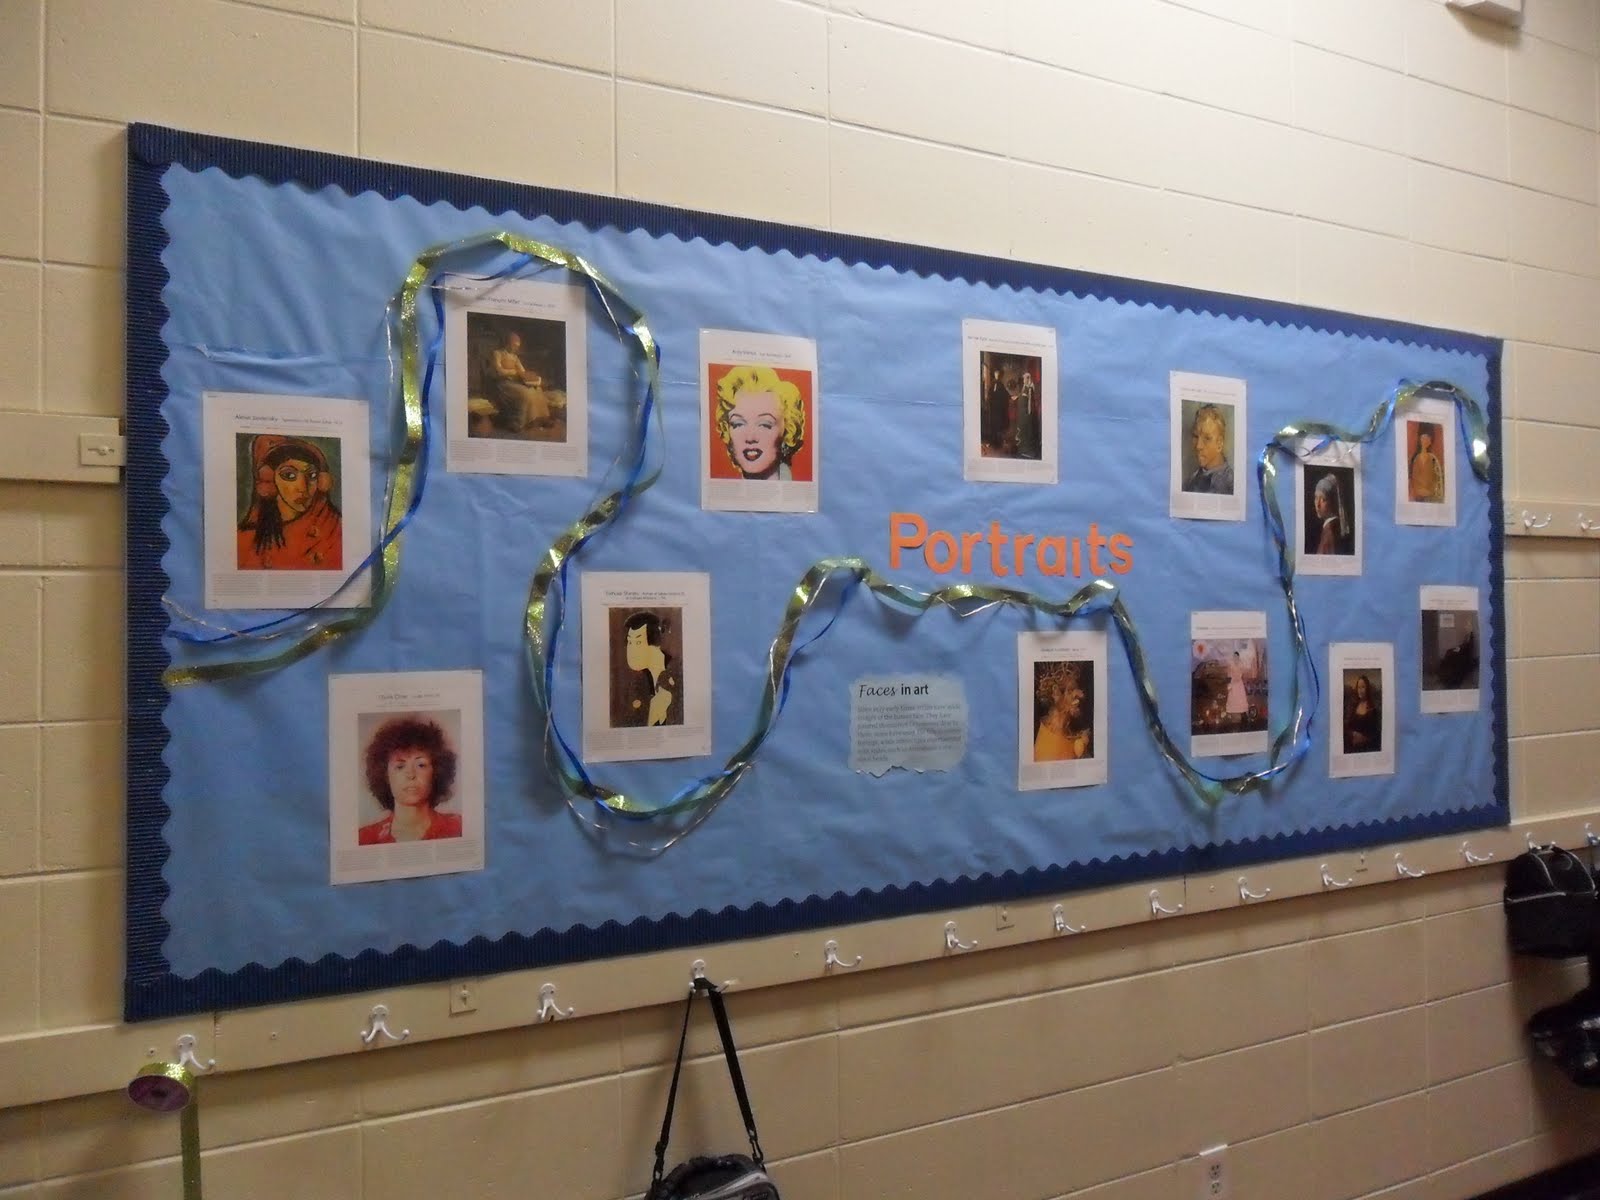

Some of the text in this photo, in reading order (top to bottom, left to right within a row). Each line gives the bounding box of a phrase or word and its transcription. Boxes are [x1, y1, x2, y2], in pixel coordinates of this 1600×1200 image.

[889, 512, 1134, 578] Portraits
[859, 684, 929, 698] Faces in art
